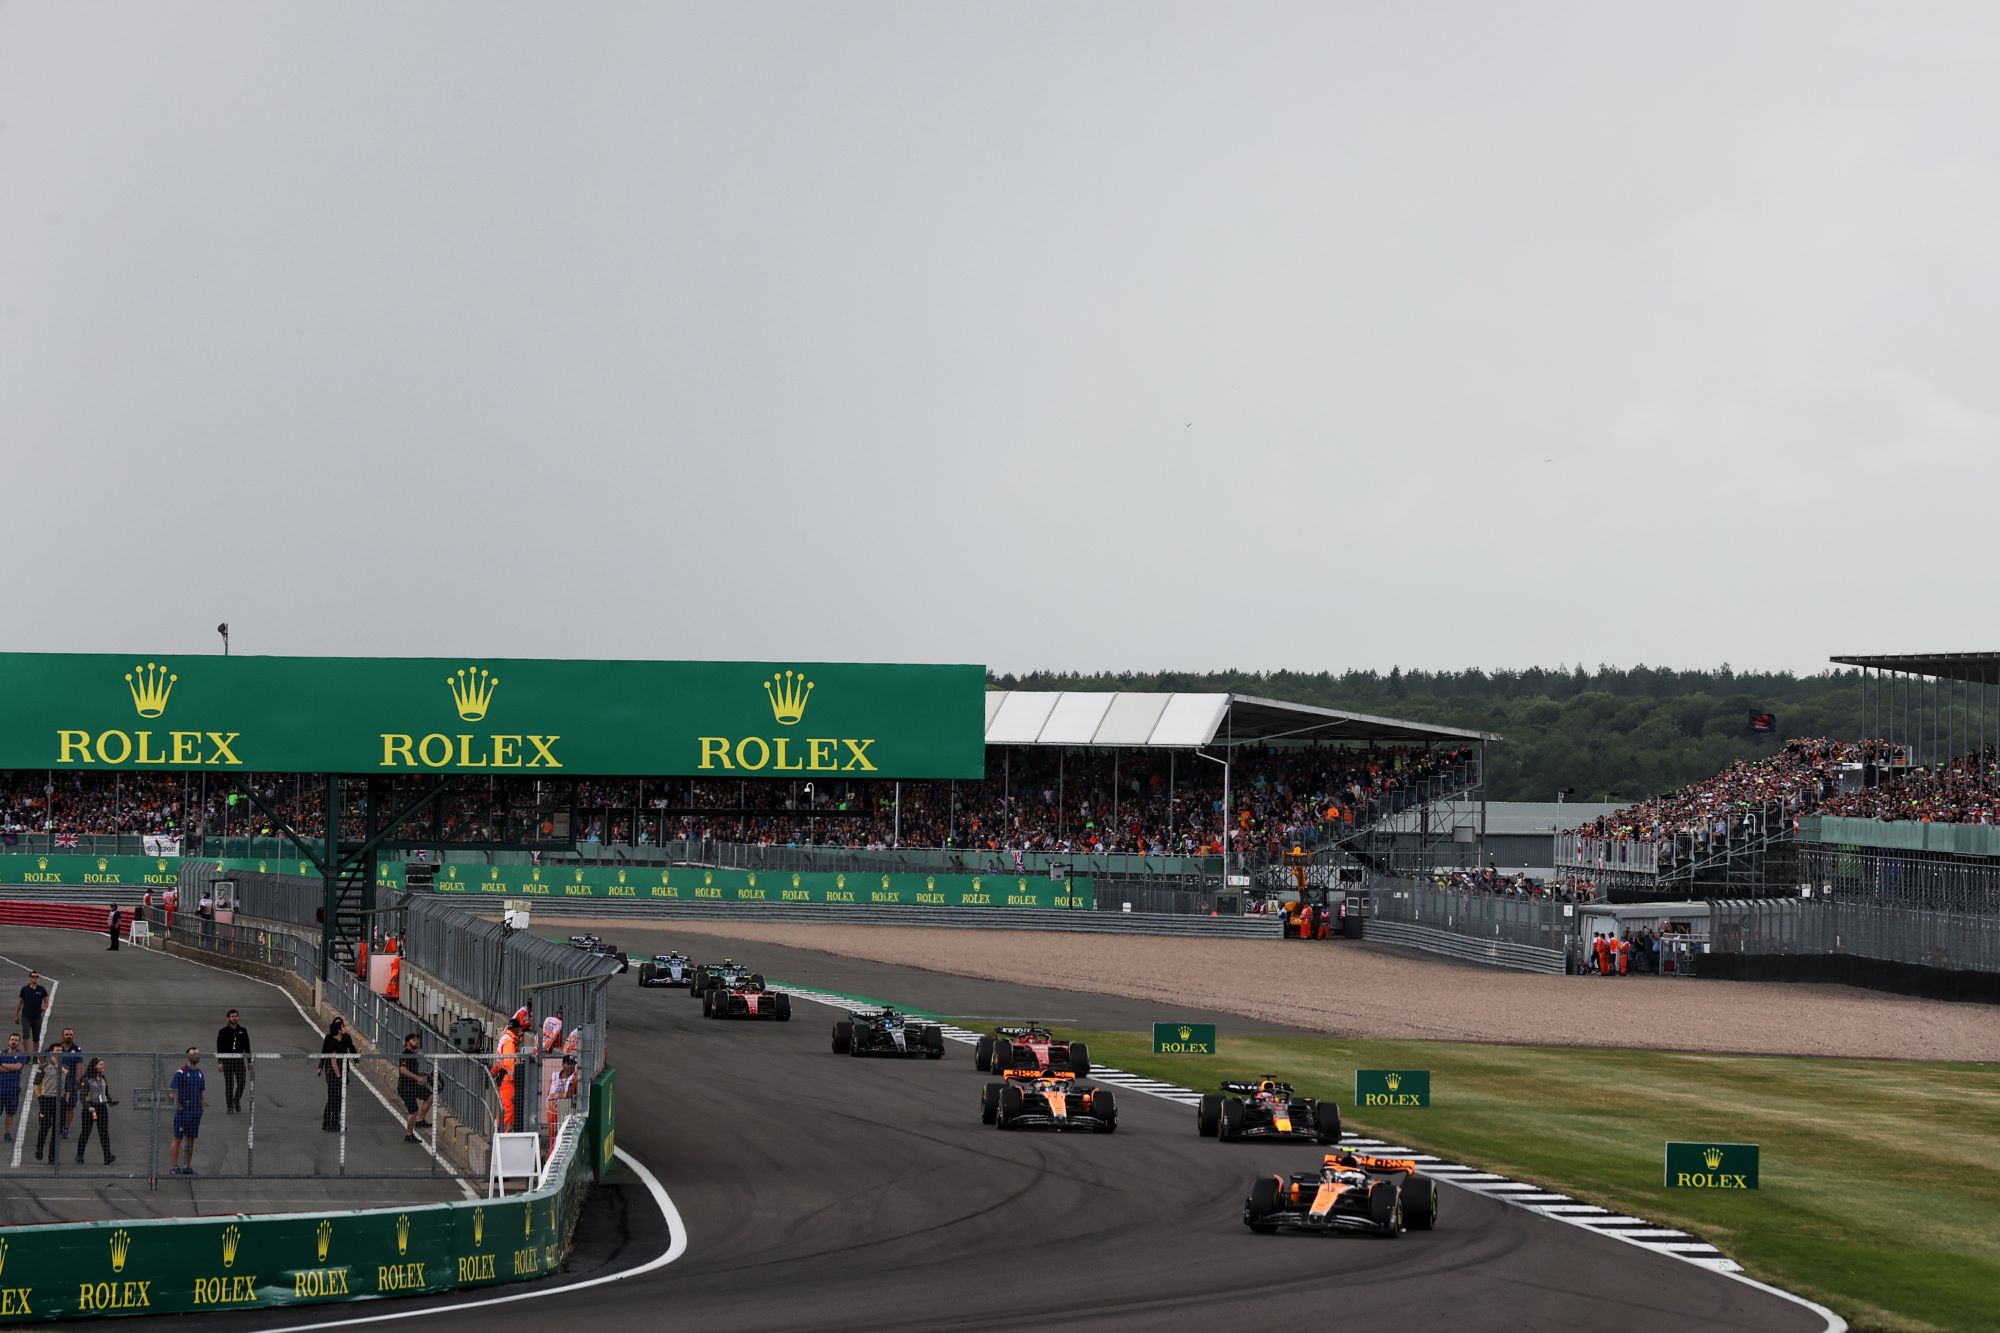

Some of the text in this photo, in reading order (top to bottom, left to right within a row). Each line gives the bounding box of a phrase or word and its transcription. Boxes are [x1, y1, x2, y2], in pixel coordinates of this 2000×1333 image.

[57, 729, 243, 766] ROLEX
[380, 733, 562, 768] ROLEX
[697, 736, 878, 772] ROLEX
[24, 873, 61, 882] ROLEX
[85, 874, 120, 883] ROLEX
[377, 879, 397, 888] OLEX
[439, 882, 465, 891] ROLEX
[481, 883, 507, 892] ROLEX
[523, 884, 549, 894] ROLEX
[566, 885, 592, 895] ROLEX
[608, 886, 635, 896] ROLEX
[651, 887, 678, 897] ROLEX
[695, 888, 722, 898] ROLEX
[738, 889, 765, 899] ROLEX
[782, 890, 809, 900] ROLEX
[827, 891, 854, 901] ROLEX
[871, 892, 898, 902] ROLEX
[917, 893, 944, 903] ROLEX
[962, 894, 990, 904] ROLEX
[1008, 895, 1036, 905] ROLEX
[1161, 1042, 1208, 1053] ROLEX
[1365, 1093, 1420, 1106] ROLEX
[1677, 1172, 1747, 1189] ROLEX
[514, 1247, 538, 1275] ROLEX
[457, 1253, 496, 1282] ROLEX
[377, 1263, 426, 1292] ROLEX
[294, 1269, 349, 1298] ROLEX
[193, 1275, 257, 1304] ROLEX
[78, 1280, 152, 1311] ROLEX
